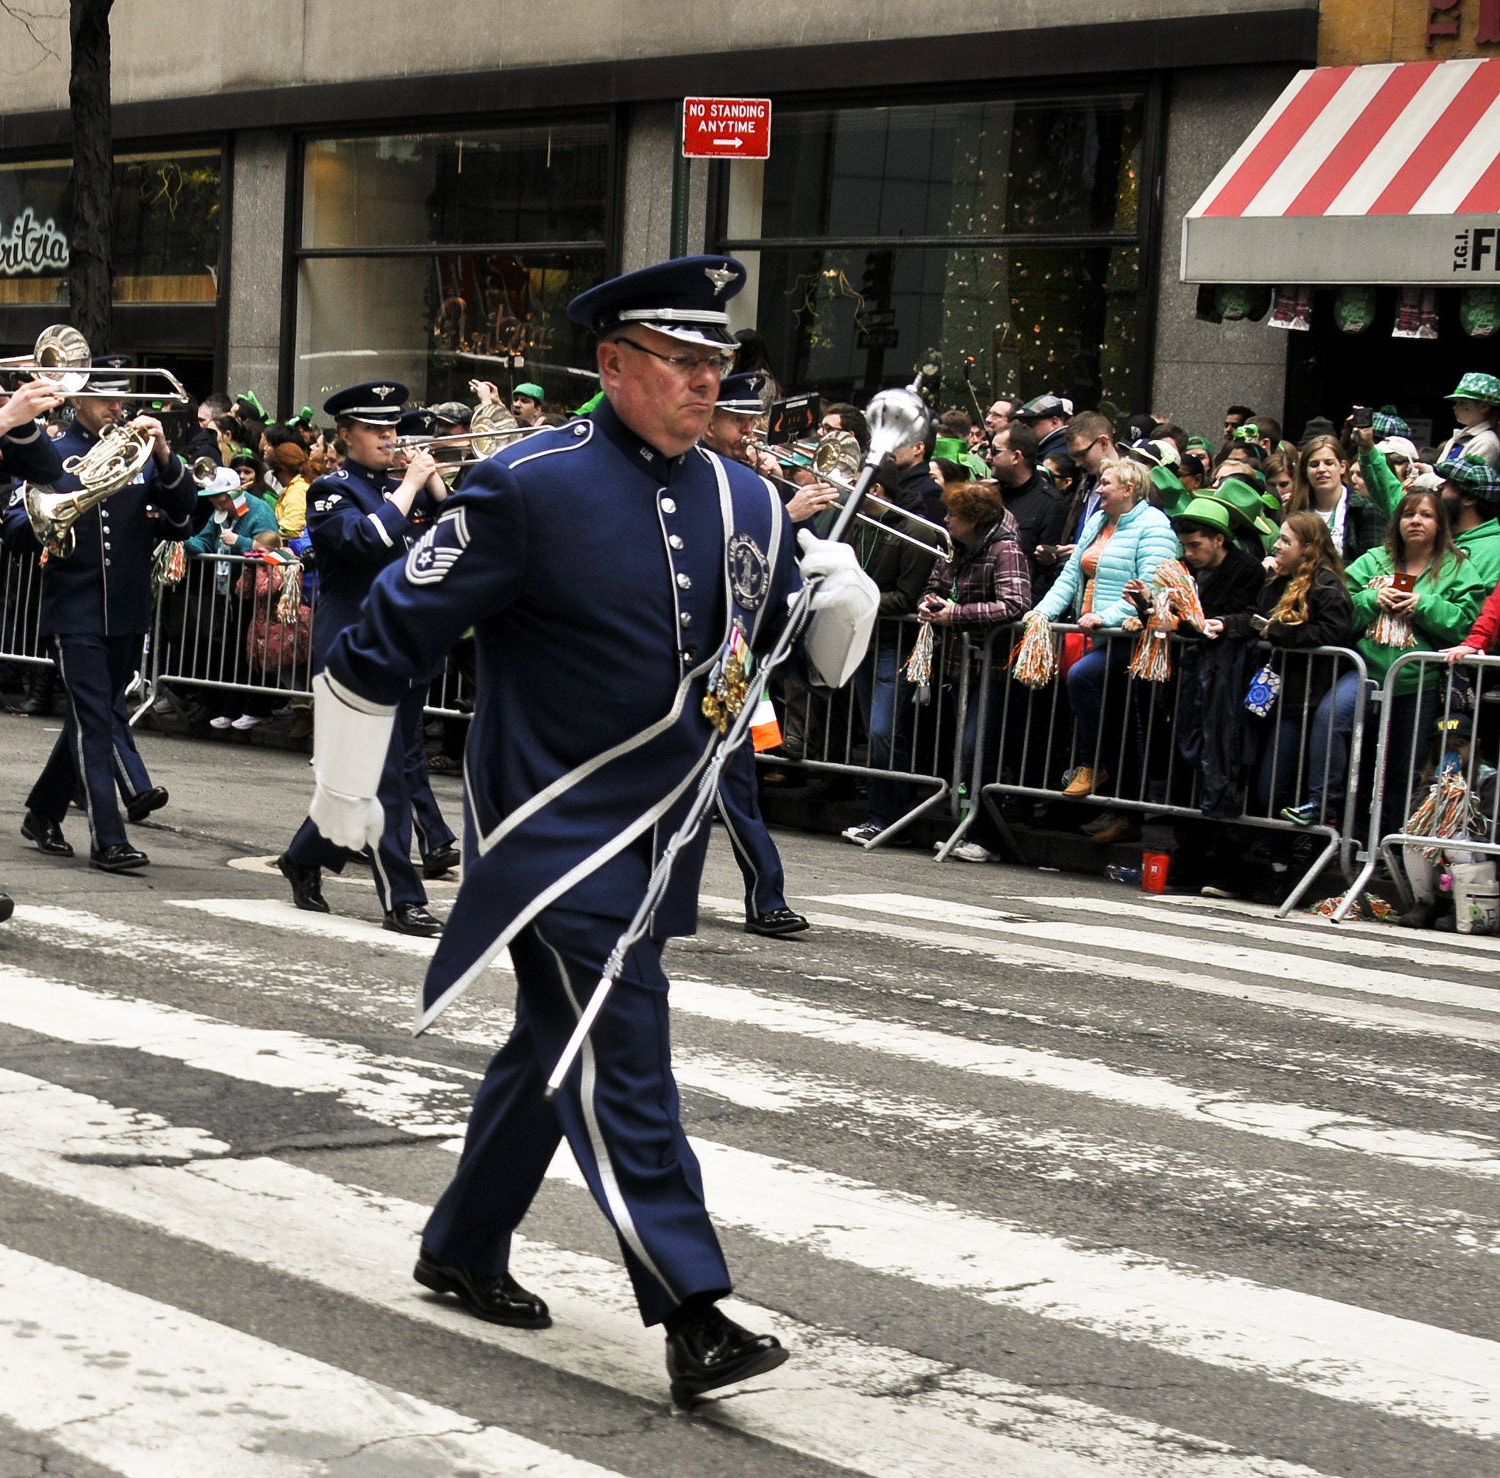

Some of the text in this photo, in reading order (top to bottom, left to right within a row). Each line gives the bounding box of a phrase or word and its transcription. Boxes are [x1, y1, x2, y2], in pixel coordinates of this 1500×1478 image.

[689, 104, 764, 118] NO STANDING
[698, 120, 756, 134] ANYTIME
[1453, 229, 1469, 272] T.G.I.
[1437, 719, 1460, 731] NVY
